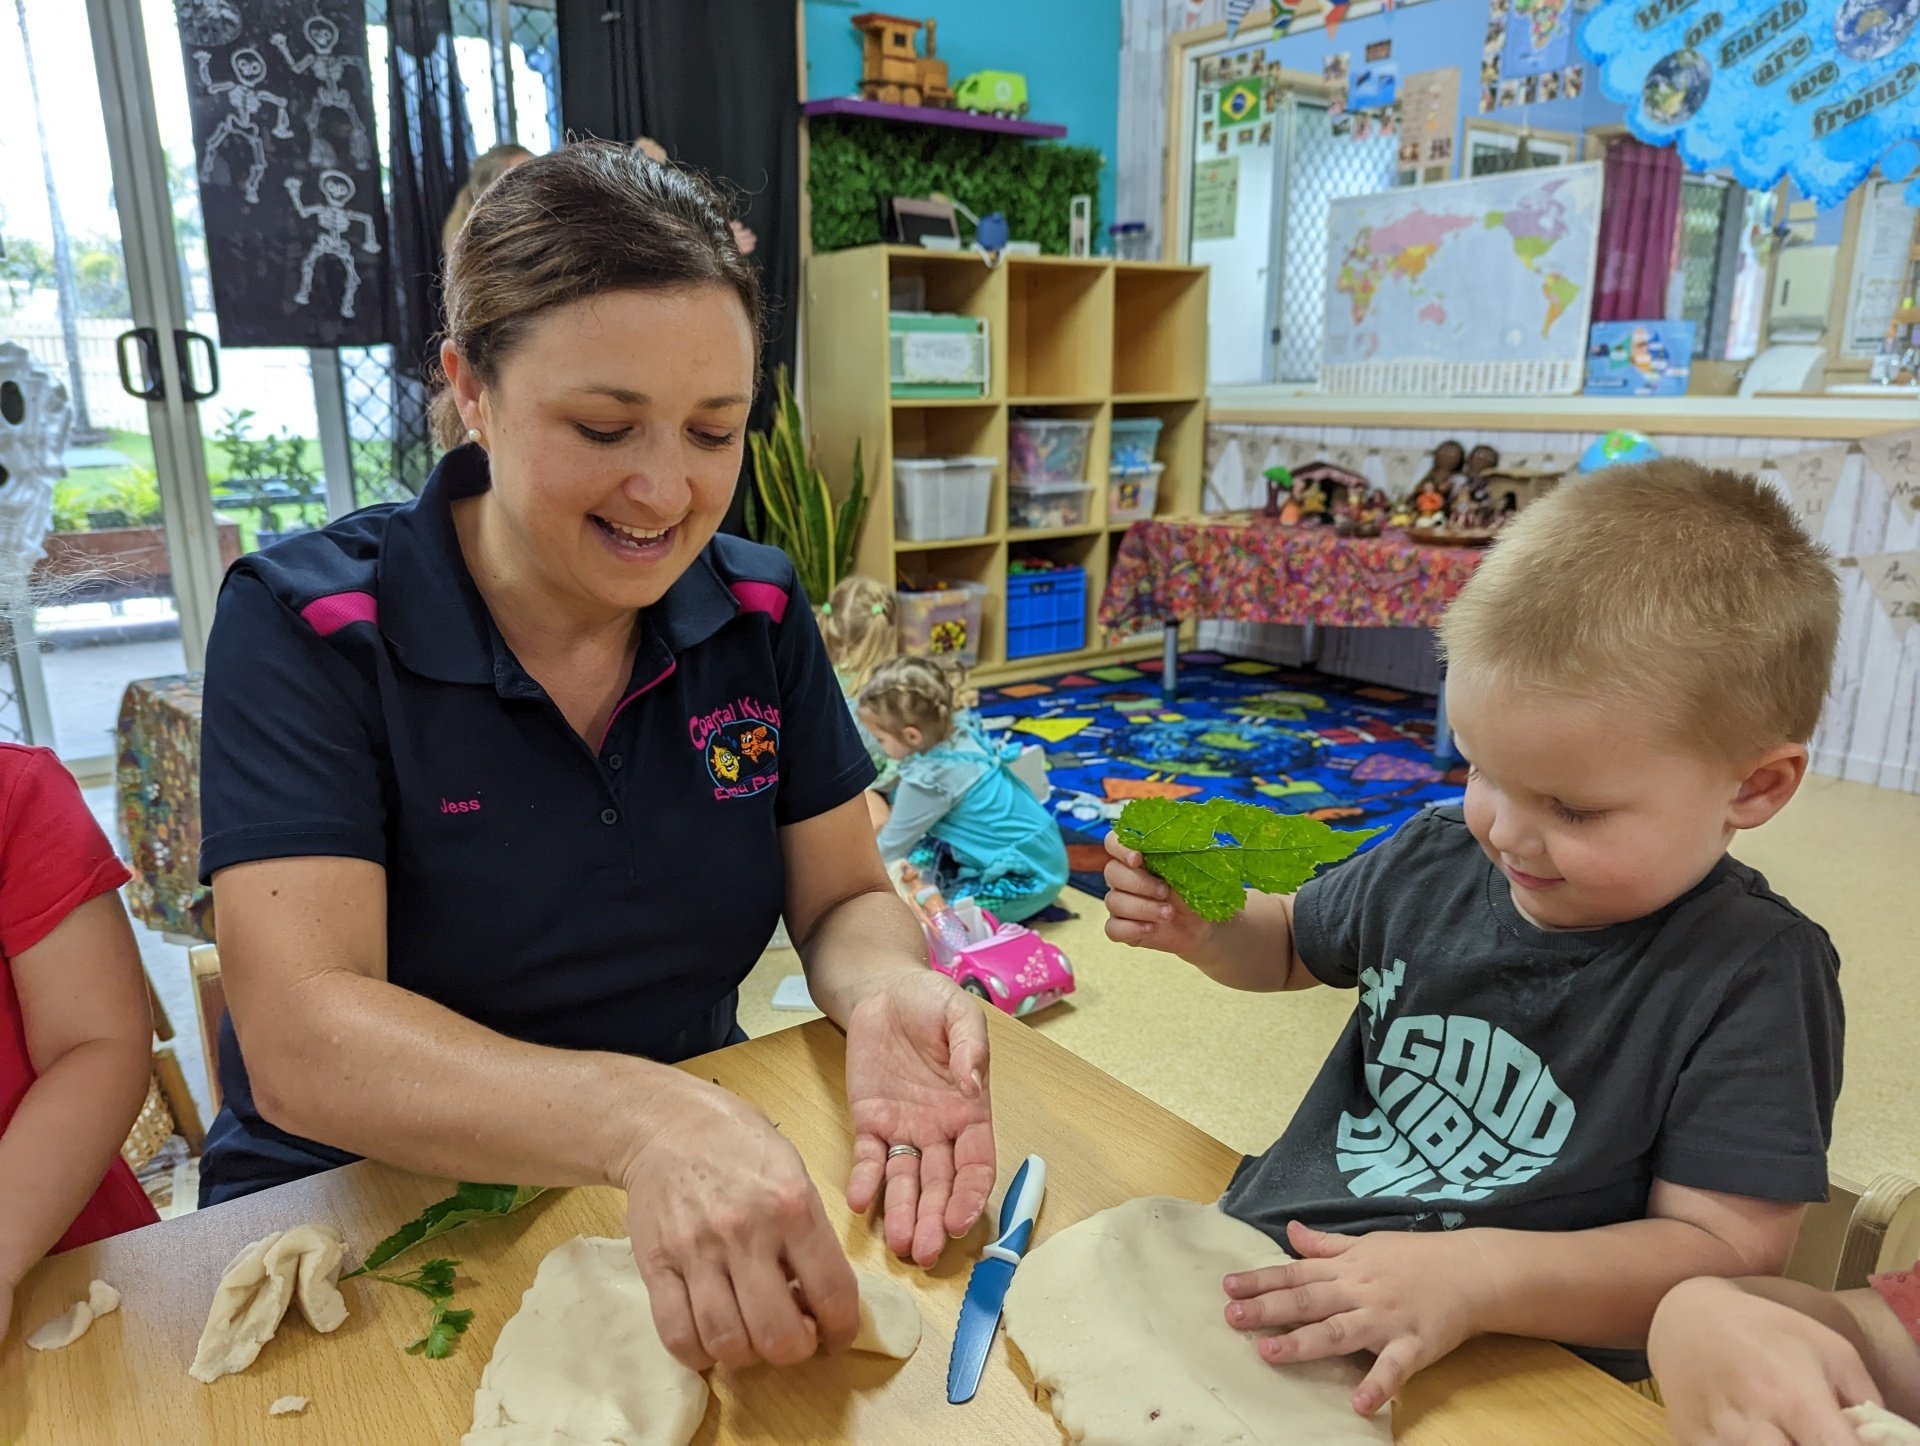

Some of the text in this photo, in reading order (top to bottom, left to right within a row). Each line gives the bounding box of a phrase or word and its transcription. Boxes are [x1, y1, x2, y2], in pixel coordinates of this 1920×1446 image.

[1685, 11, 1722, 48] on
[1721, 0, 1801, 67] Earth
[1757, 36, 1807, 84] are
[1790, 63, 1834, 101] we
[1813, 64, 1917, 139] from?
[689, 696, 781, 750] Coastal Kids
[440, 798, 481, 813] Jess
[714, 783, 749, 800] Emu
[1377, 1014, 1577, 1156] GOOD
[1364, 1063, 1558, 1187] VIBES
